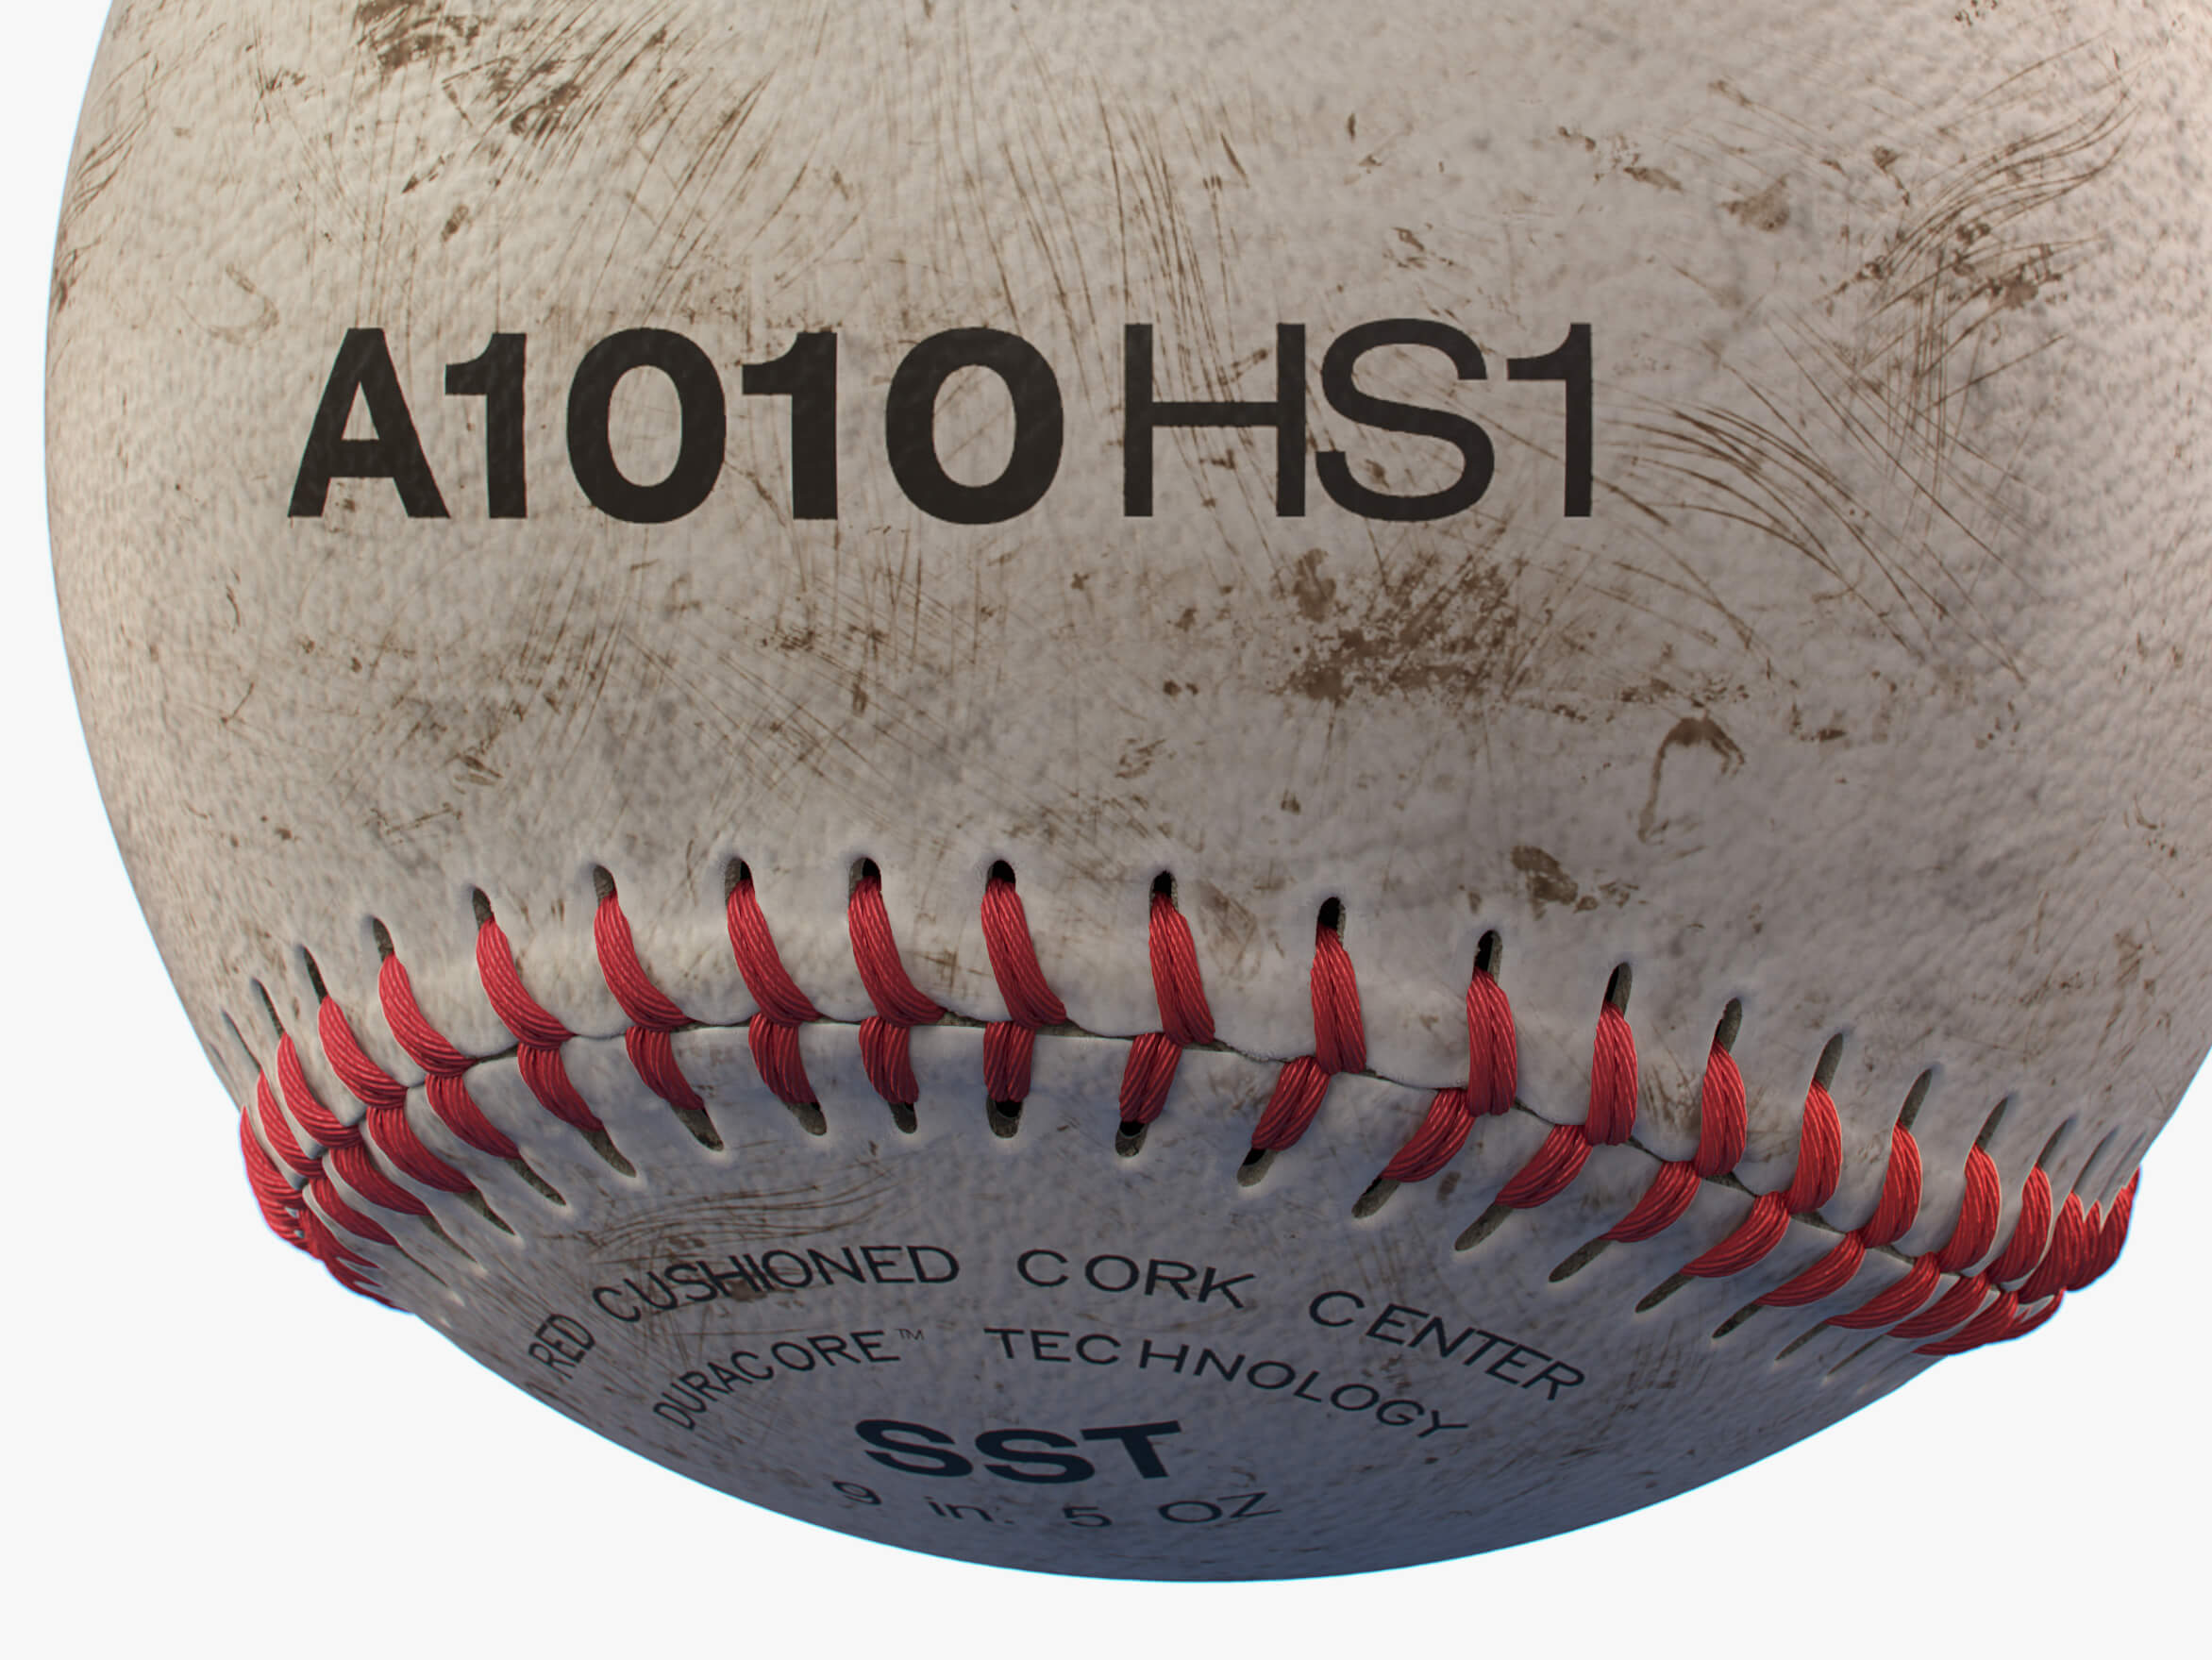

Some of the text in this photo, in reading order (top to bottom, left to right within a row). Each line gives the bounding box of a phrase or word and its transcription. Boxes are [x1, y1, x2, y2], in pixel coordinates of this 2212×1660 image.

[287, 317, 1594, 525] A1010 HS1
[528, 1245, 1585, 1400] RED CUSHIONED CORK CENTER
[983, 1328, 1468, 1437] TECHNOLOGY
[832, 1481, 882, 1505] 9
[1061, 1506, 1114, 1527] 5
[855, 1419, 1181, 1484] SST
